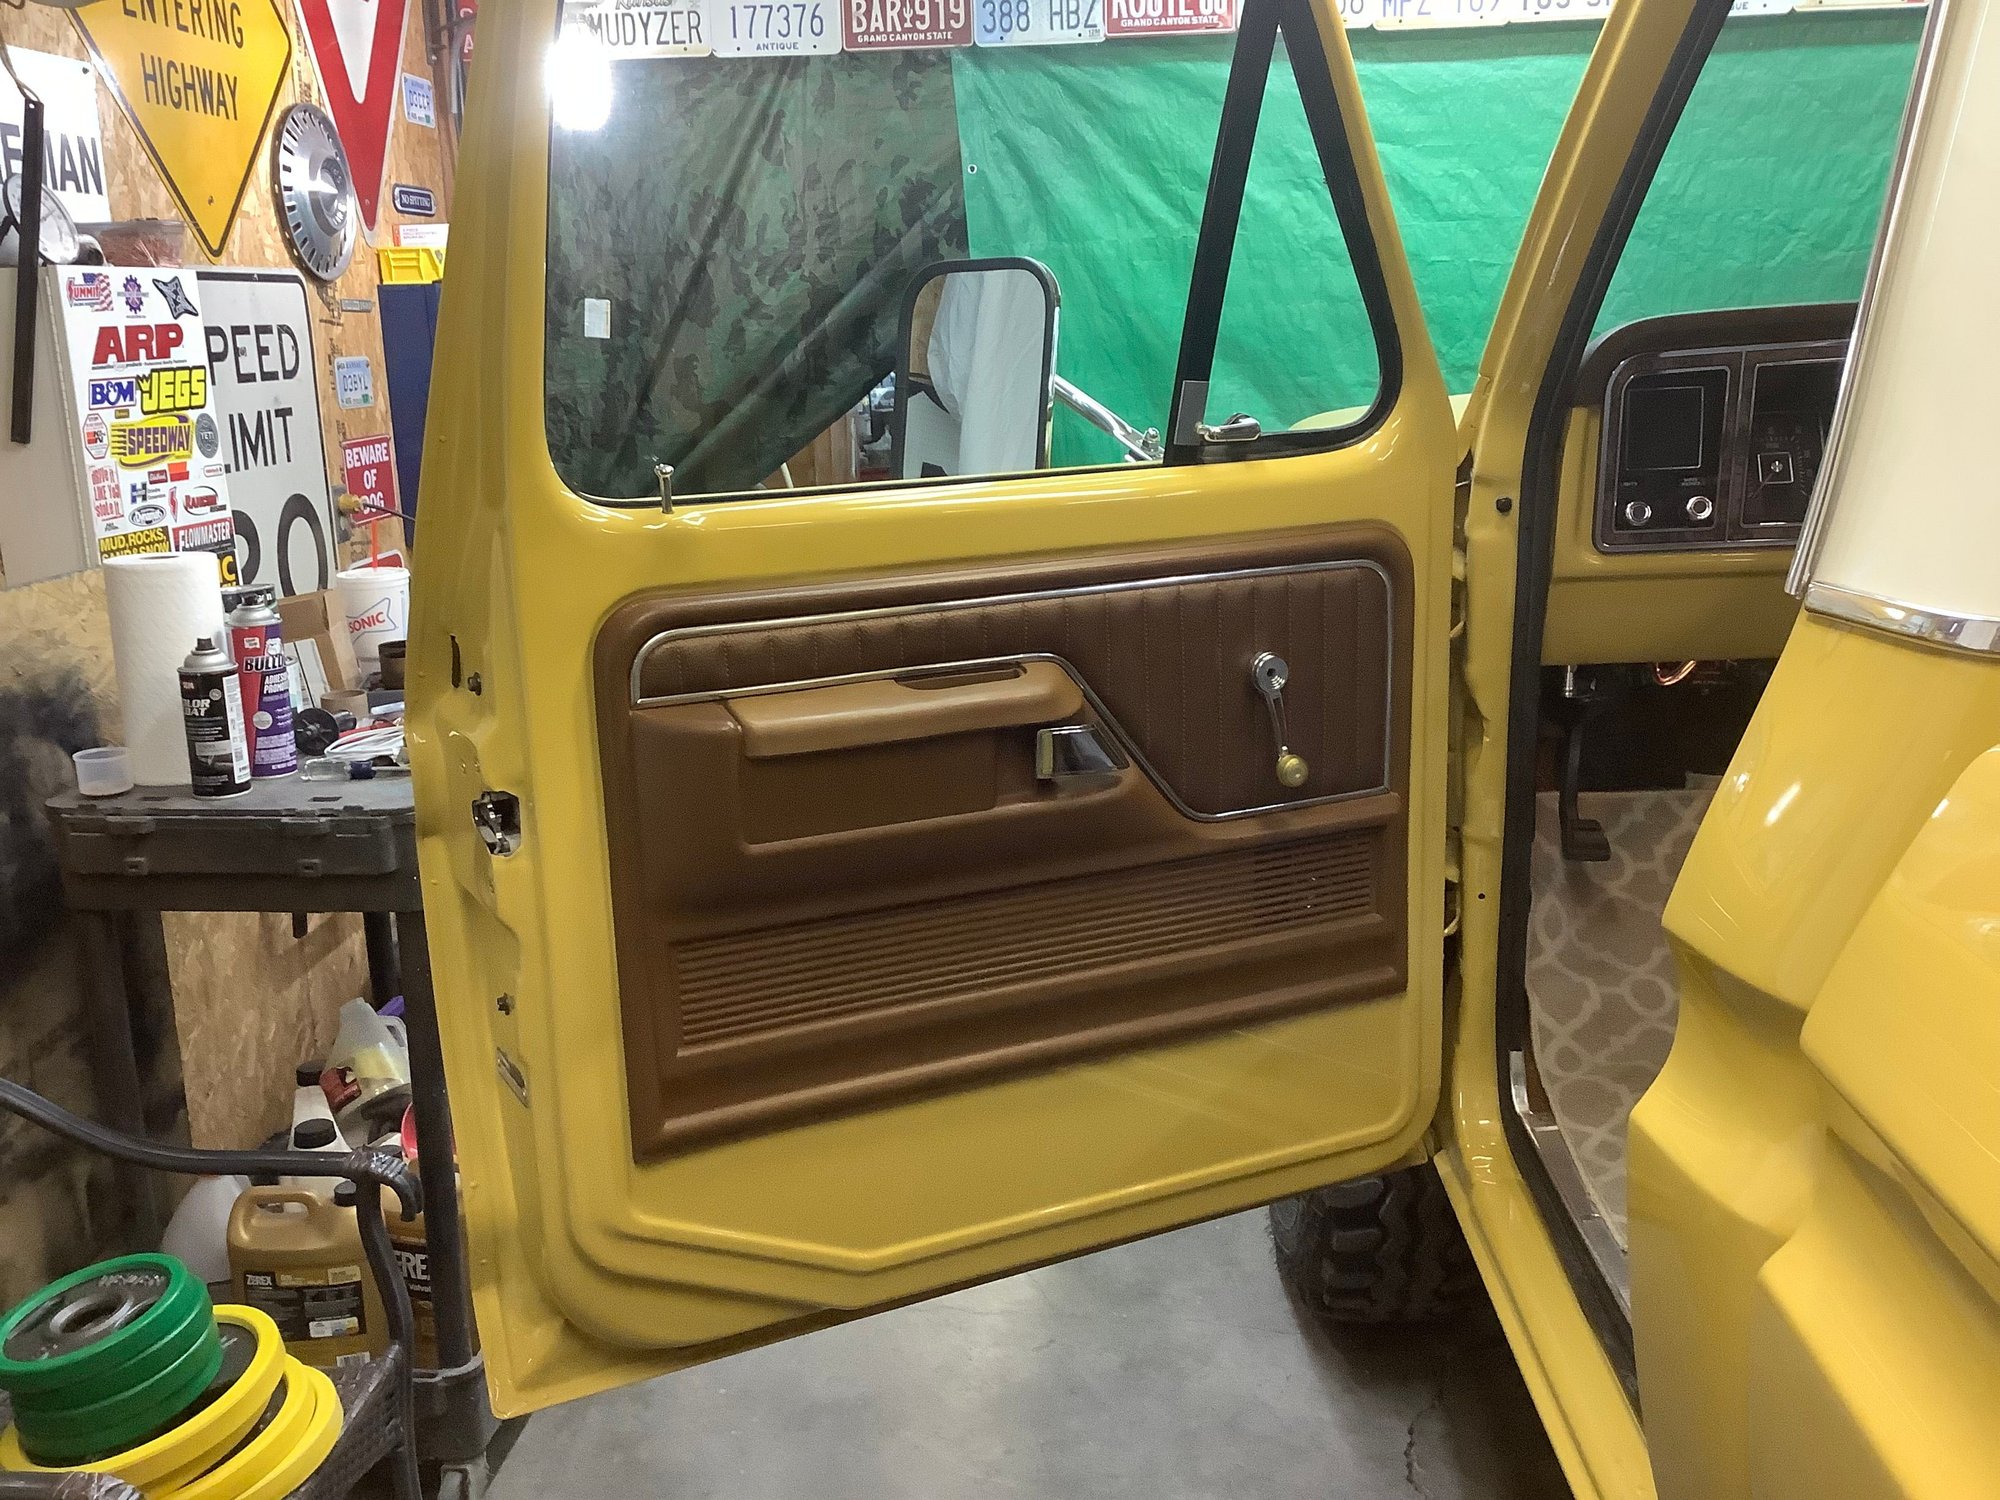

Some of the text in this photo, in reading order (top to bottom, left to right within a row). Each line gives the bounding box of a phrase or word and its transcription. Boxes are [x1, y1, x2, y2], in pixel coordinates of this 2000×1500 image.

[730, 3, 824, 39] 177376
[852, 0, 966, 33] BAR 919
[982, 0, 1098, 33] 388 HBZ
[1121, 15, 1219, 27] GRAND CANYON STATE
[756, 42, 799, 51] ANTIQUE
[857, 31, 953, 43] GRAND CANYON STATE
[140, 52, 238, 121] HIGHWAY
[92, 323, 184, 365] ARP
[91, 380, 135, 406] B&M
[141, 366, 206, 415] JEGS
[128, 424, 191, 455] SPEEDWAY
[200, 431, 215, 440] YETI
[224, 407, 294, 474] IMIT
[345, 442, 389, 469] BEWARE
[363, 468, 377, 490] OF
[128, 528, 167, 546] ROCKS,
[179, 521, 231, 551] FLOWMASTER
[348, 611, 386, 634] SONIC
[246, 1274, 272, 1286] ZEREX
